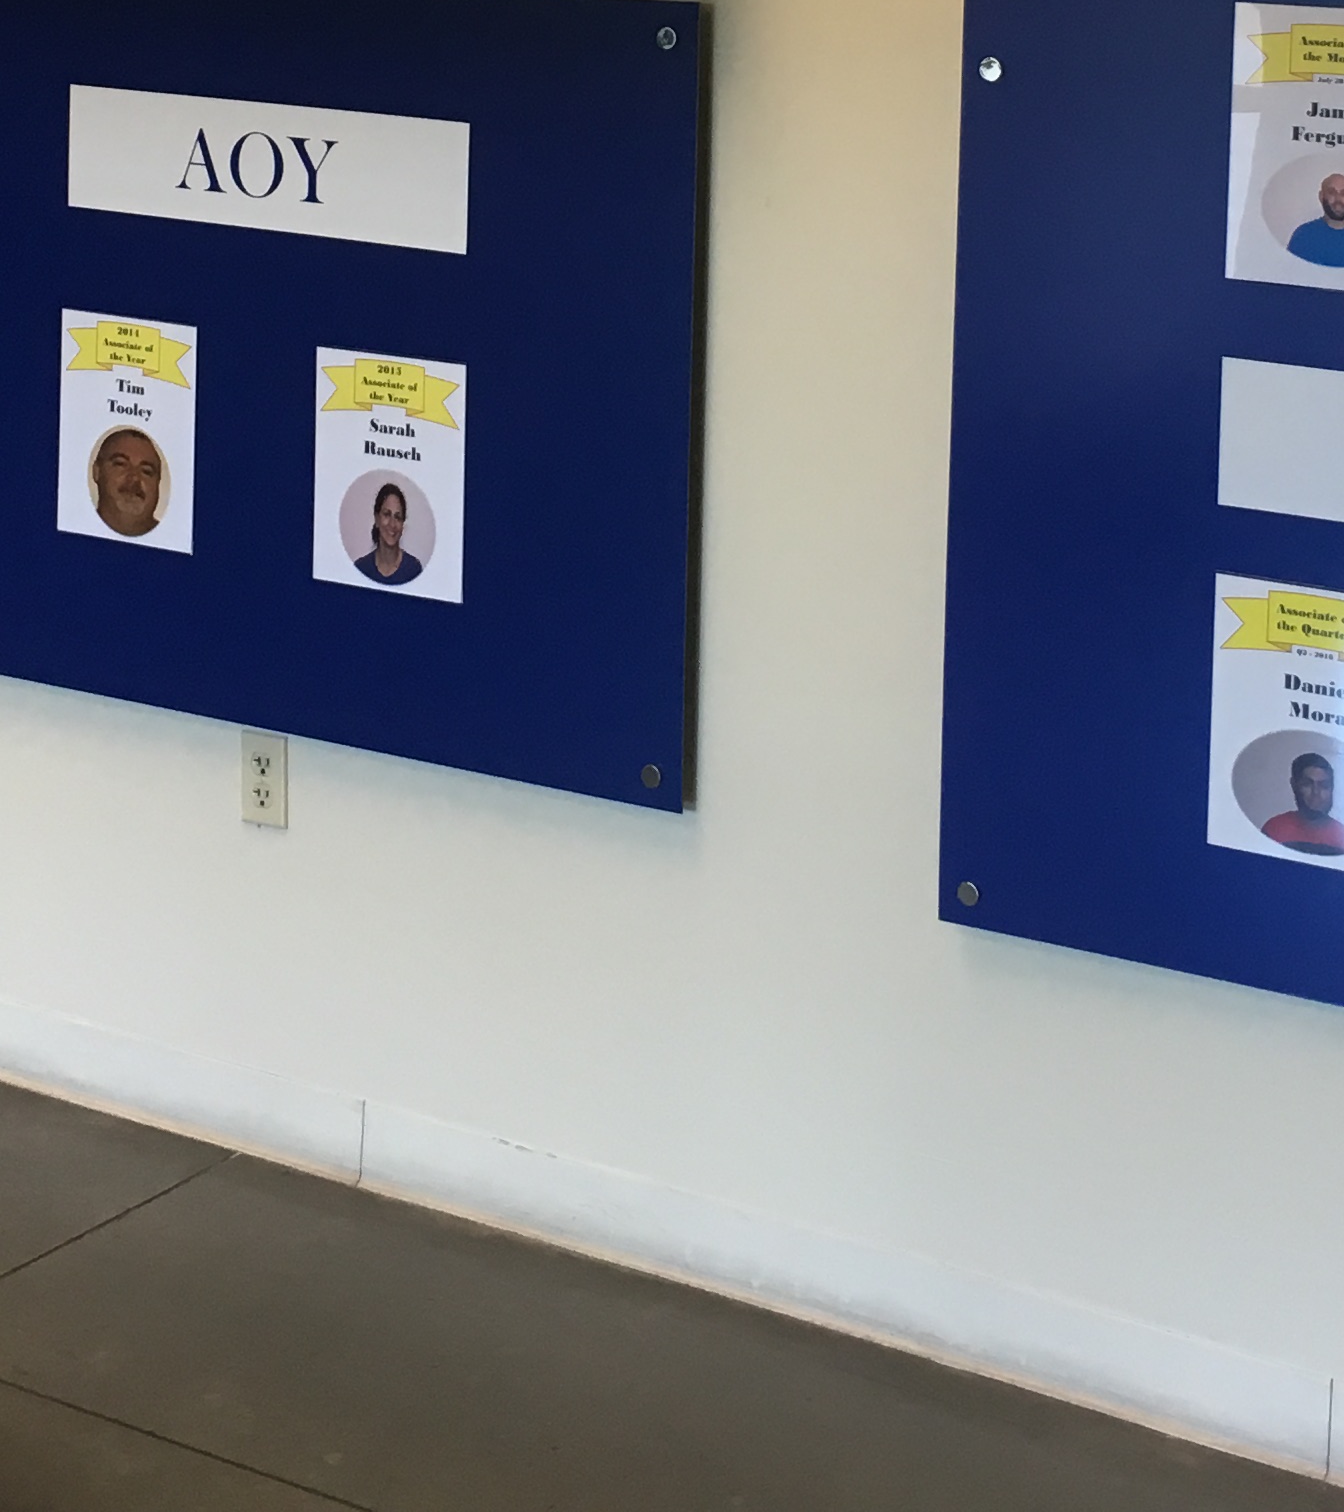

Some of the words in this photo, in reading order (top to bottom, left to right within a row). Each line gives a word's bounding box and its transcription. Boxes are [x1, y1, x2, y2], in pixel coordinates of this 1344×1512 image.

[1303, 52, 1322, 62] the
[175, 128, 339, 204] AOY
[143, 343, 154, 353] of
[109, 352, 123, 362] the
[125, 354, 146, 365] Year
[376, 364, 402, 376] 2015
[115, 379, 145, 396] Tim
[360, 375, 406, 391] Associate
[407, 381, 418, 392] of
[369, 392, 385, 403] the
[386, 393, 410, 406] Year
[107, 398, 153, 422] Tooley
[369, 418, 416, 438] Sarah
[363, 440, 421, 462] Rausch
[1276, 604, 1338, 622] Associate
[1276, 620, 1298, 632] the
